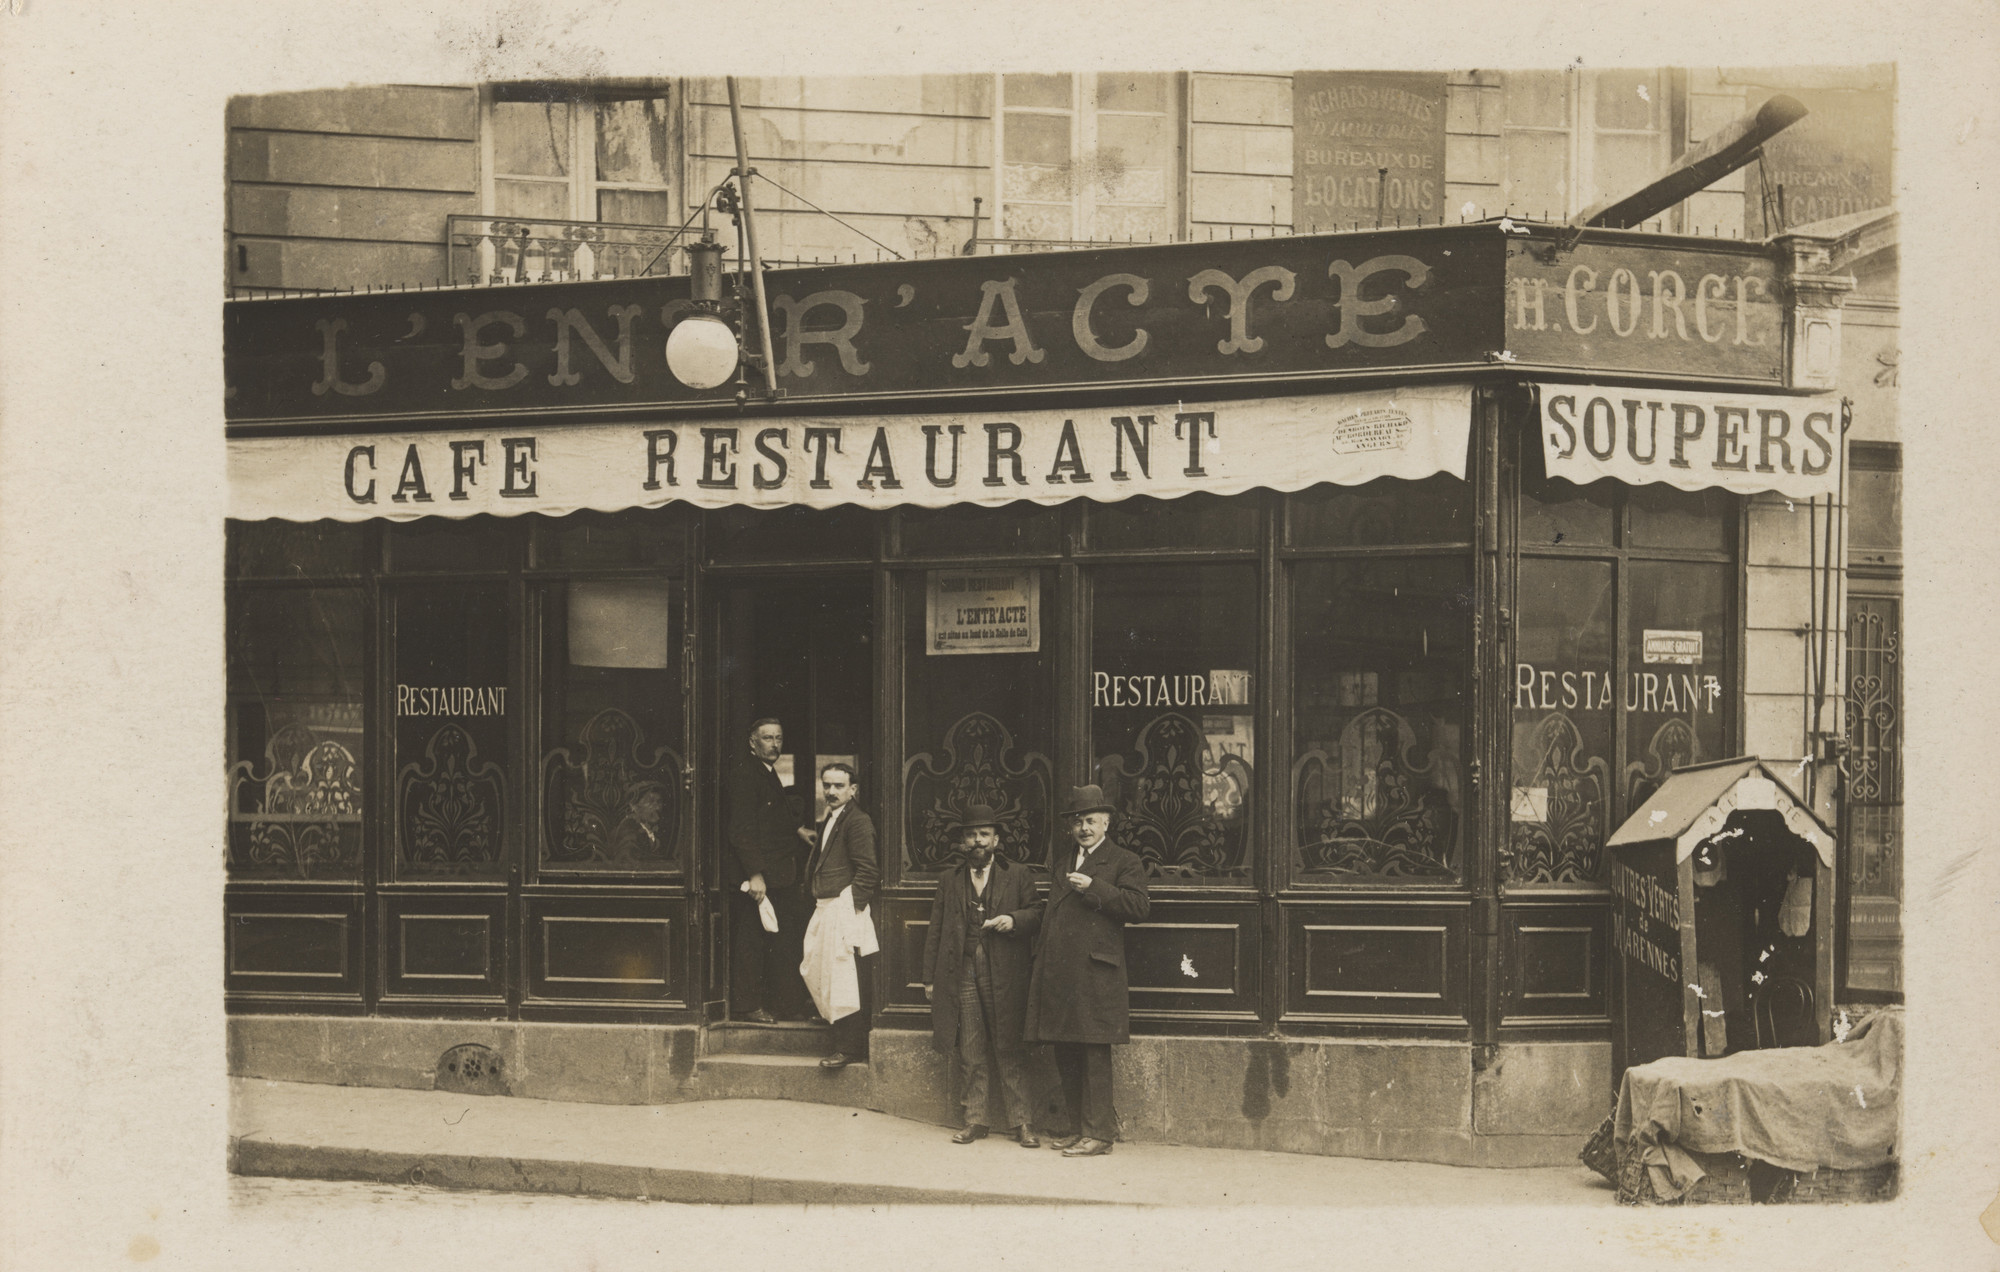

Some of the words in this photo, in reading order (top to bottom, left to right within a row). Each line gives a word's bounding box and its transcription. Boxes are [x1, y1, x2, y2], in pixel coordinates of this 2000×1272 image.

[1305, 150, 1405, 169] BUREAUX
[1408, 154, 1433, 169] DE
[310, 254, 1433, 397] L'ENR'ACTE
[1547, 393, 1836, 476] SOUPERS
[344, 436, 539, 505] CAFE
[642, 411, 1220, 490] RESTAURANT
[956, 605, 1027, 625] L'ENTR'ACTE
[397, 683, 507, 716] RESTAURANT
[1093, 671, 1252, 707] RESTAURANT
[1639, 911, 1648, 933] de
[1613, 912, 1678, 983] MARENNES
